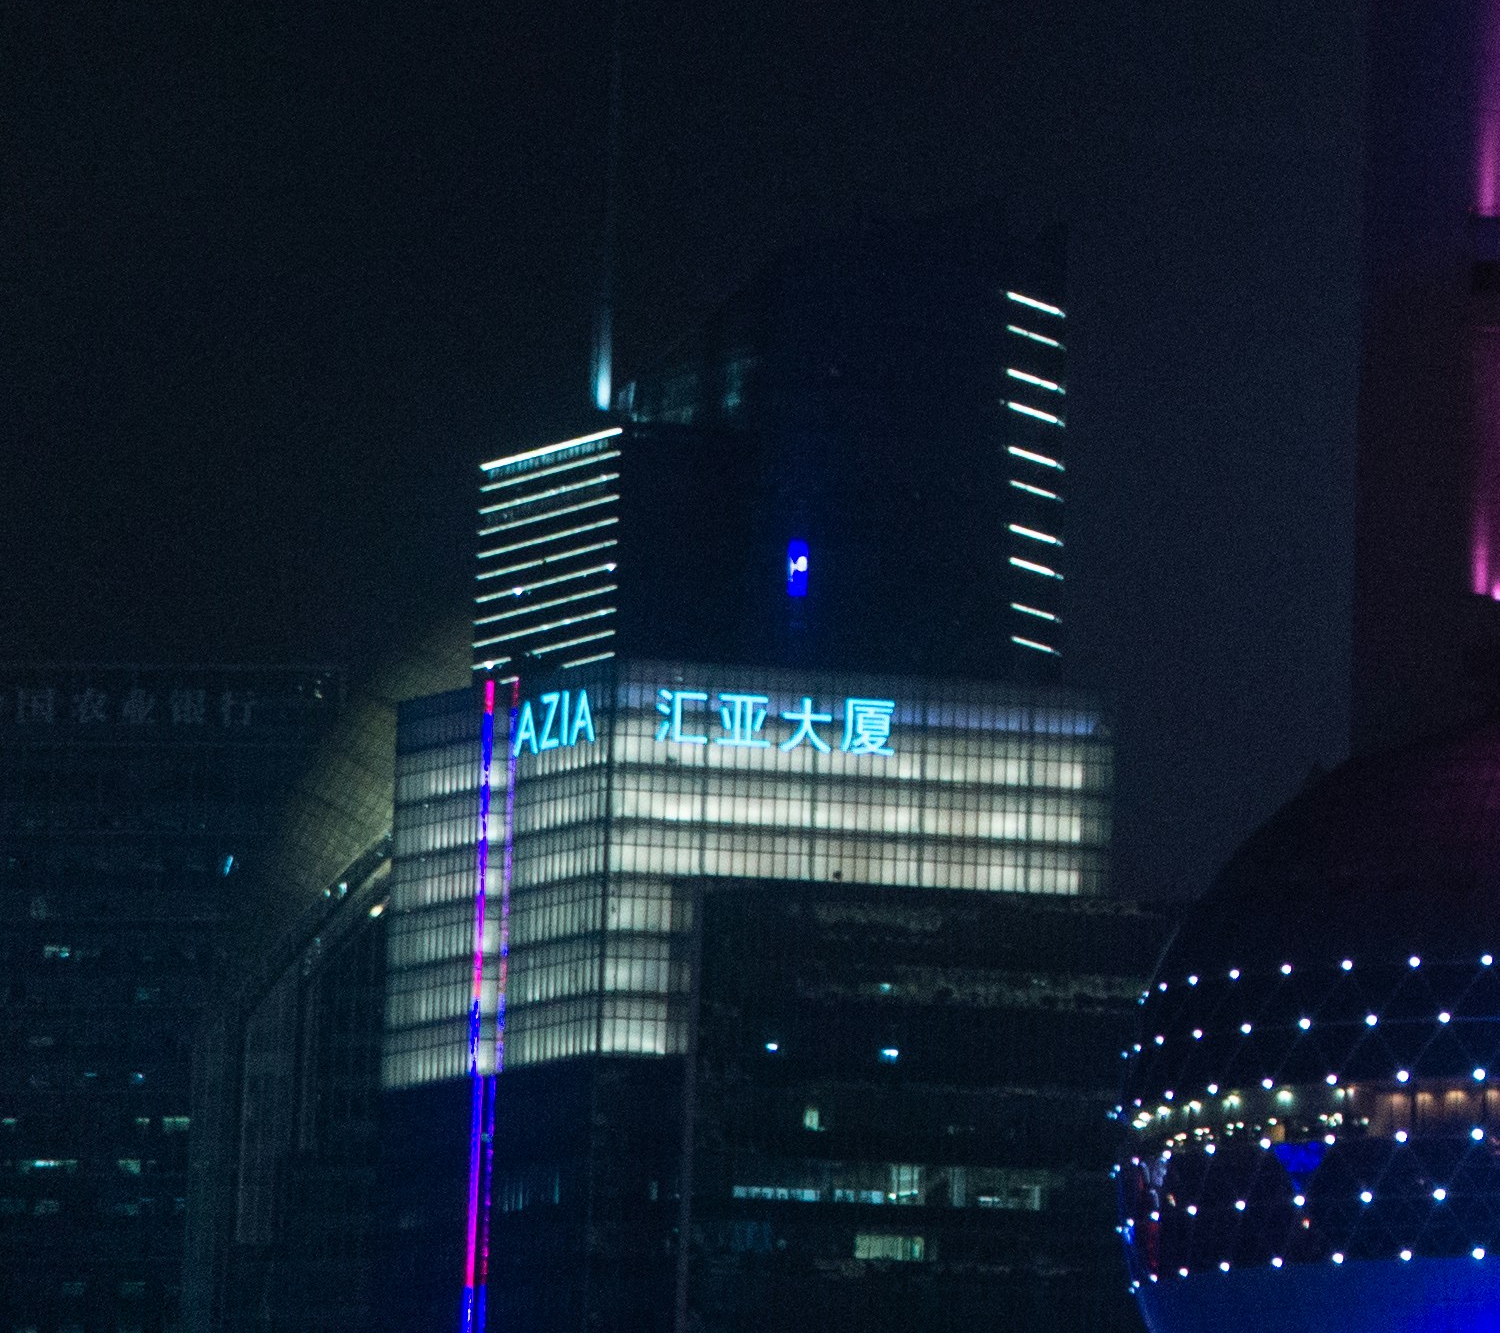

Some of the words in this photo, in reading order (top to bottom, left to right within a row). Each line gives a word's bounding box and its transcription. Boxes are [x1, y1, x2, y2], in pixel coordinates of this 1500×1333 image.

[514, 689, 595, 757] AZIA
[655, 689, 896, 756] 汇亚大厦
